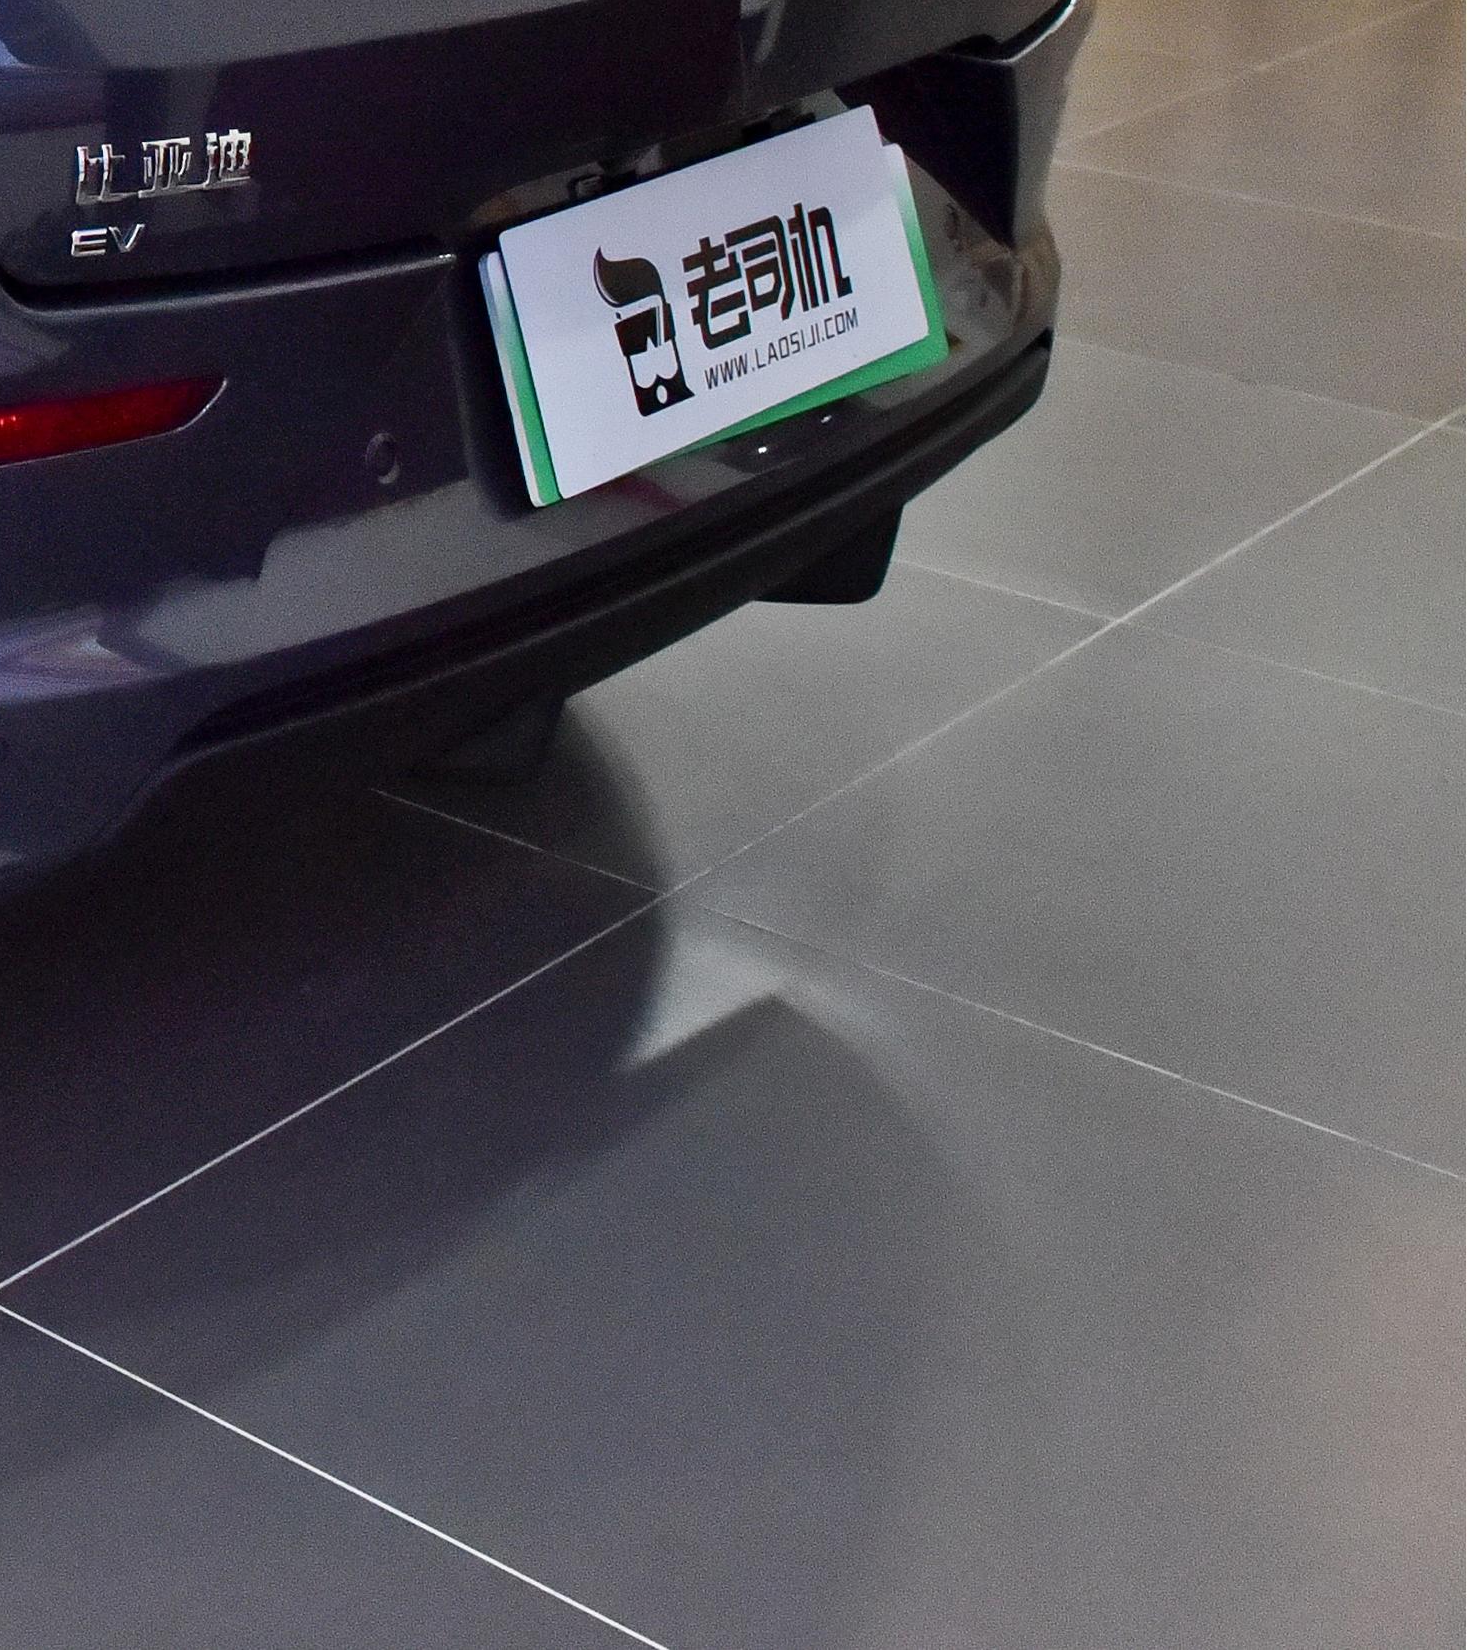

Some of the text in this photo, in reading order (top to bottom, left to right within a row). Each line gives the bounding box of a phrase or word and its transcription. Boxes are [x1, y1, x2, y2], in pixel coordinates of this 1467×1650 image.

[75, 128, 251, 204] 比亚迪
[71, 223, 145, 257] EV
[681, 202, 853, 350] 老司机
[704, 307, 860, 390] WWW.LAOSIJI.COM
